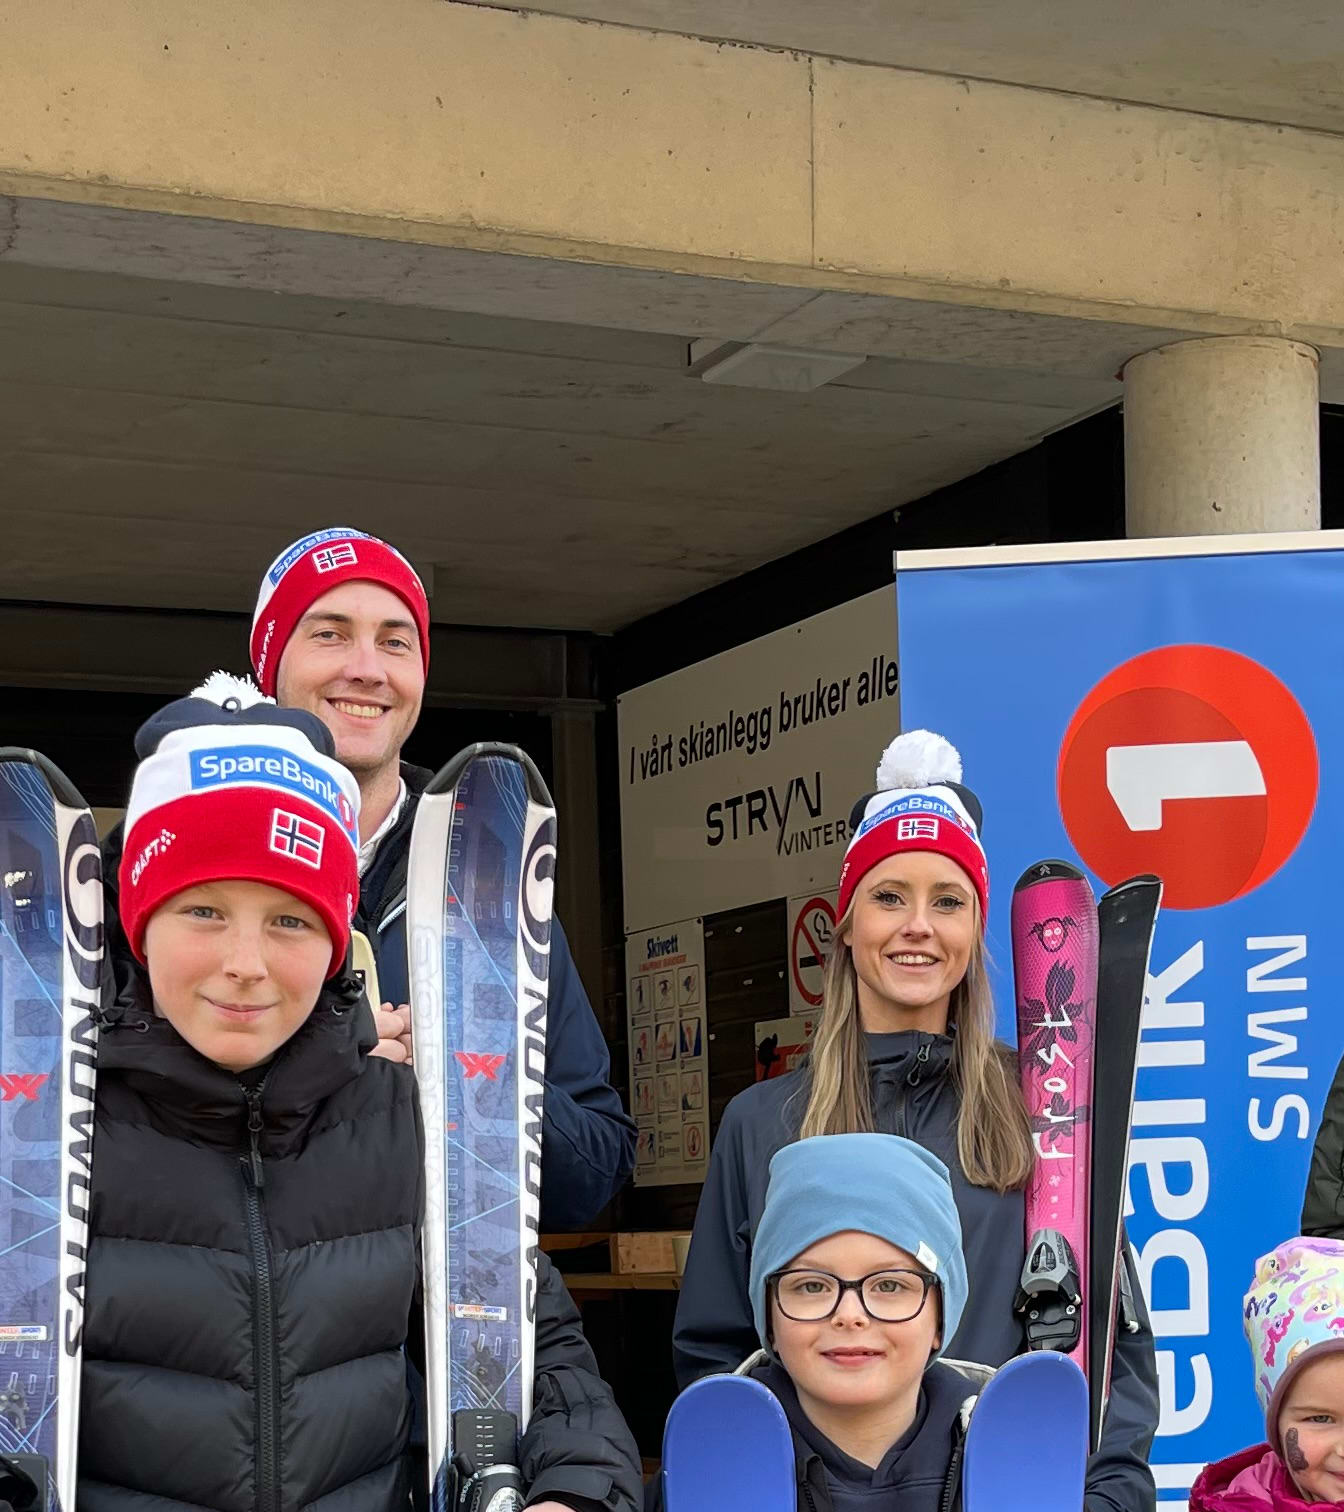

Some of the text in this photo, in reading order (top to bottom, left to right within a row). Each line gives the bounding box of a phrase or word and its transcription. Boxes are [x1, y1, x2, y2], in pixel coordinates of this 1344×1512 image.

[629, 654, 899, 785] I vårt skianlegg bruker alle
[199, 754, 339, 809] SpareBank
[1105, 740, 1268, 832] 1
[131, 837, 160, 887] CRAFT
[1247, 934, 1311, 1143] SMN
